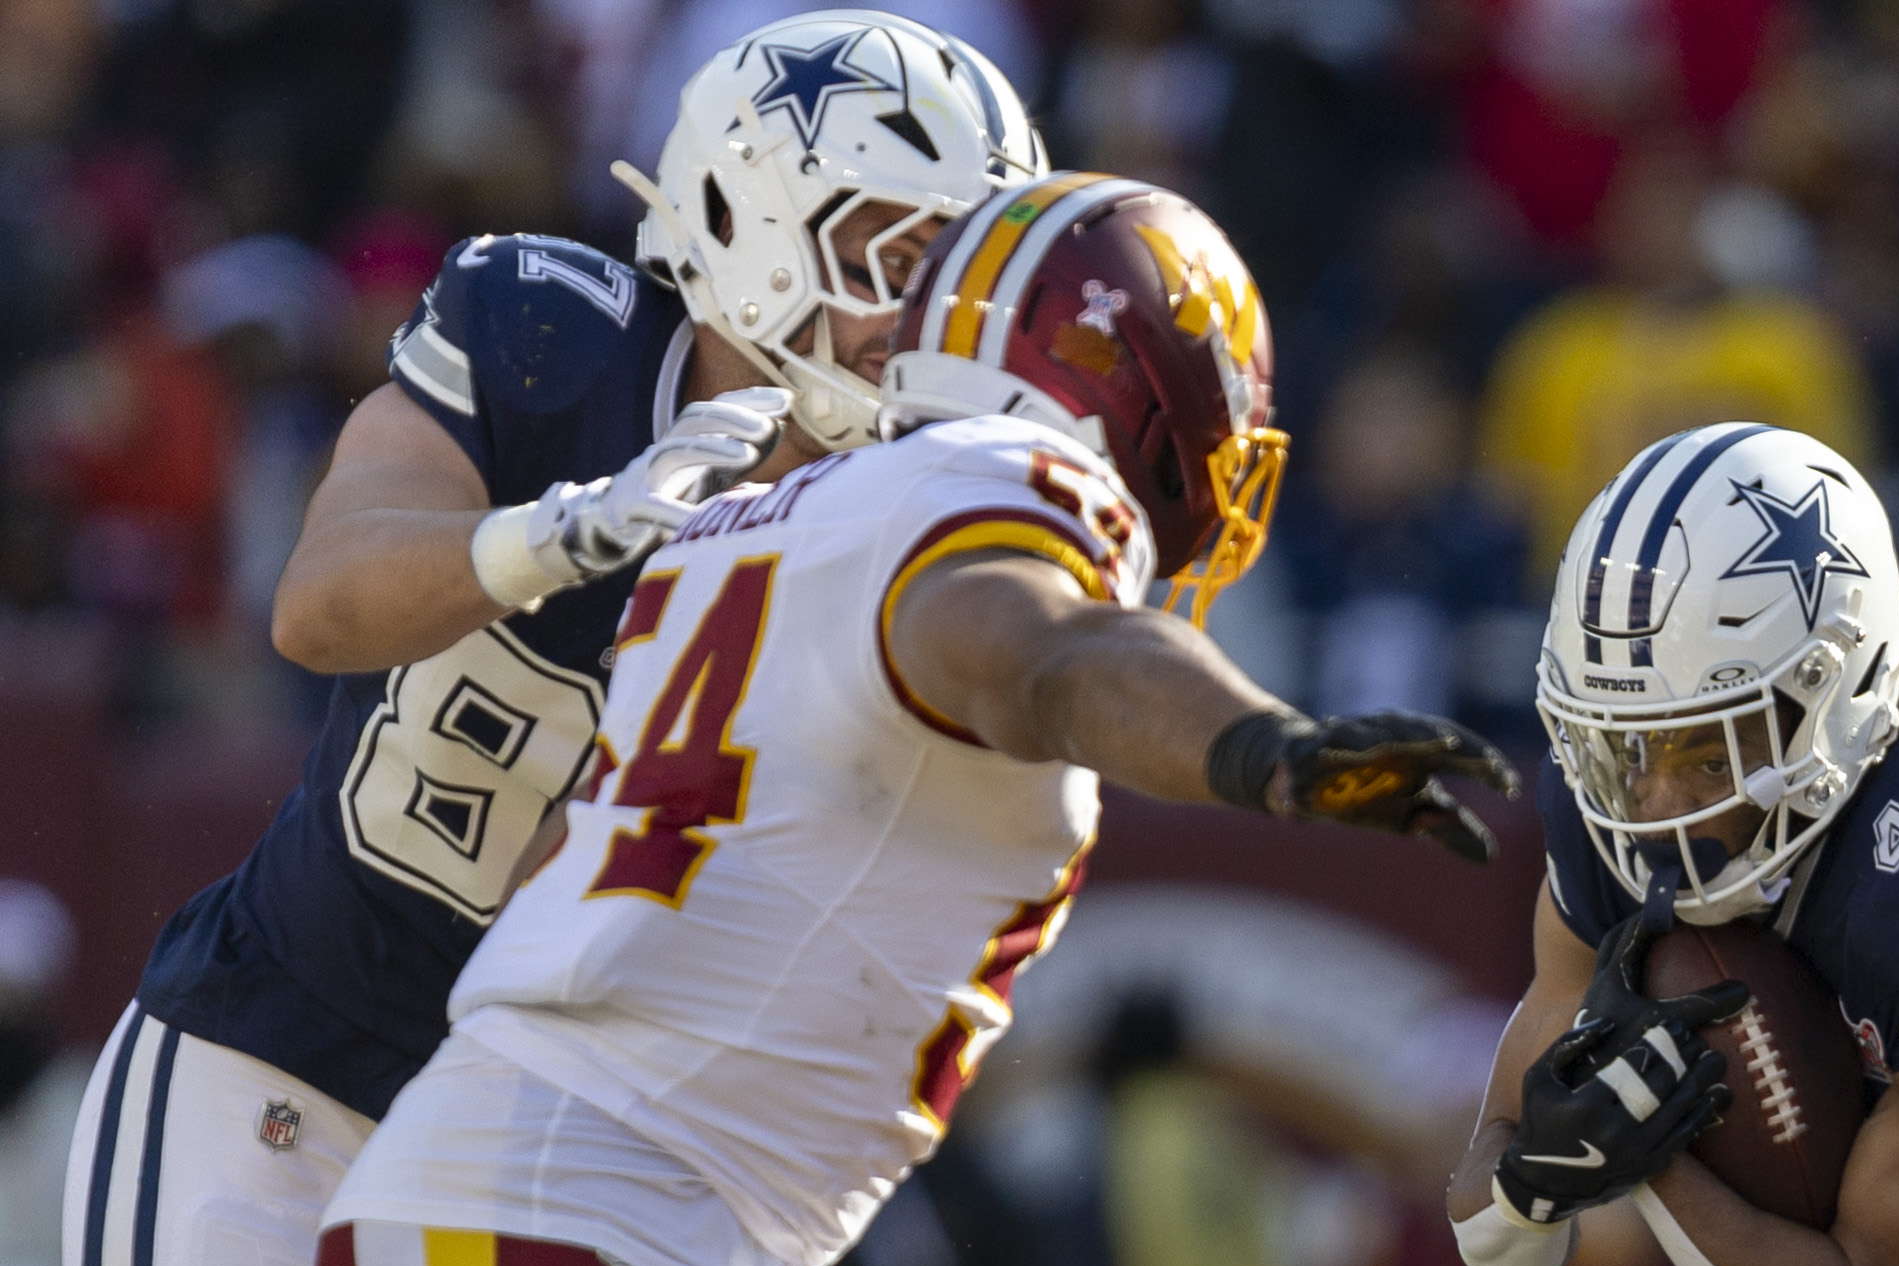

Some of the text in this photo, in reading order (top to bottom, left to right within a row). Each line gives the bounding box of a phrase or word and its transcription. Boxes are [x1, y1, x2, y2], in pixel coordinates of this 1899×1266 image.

[513, 233, 637, 331] 7
[1584, 674, 1646, 692] COWBOYS
[1702, 677, 1755, 692] OAKLEY
[264, 1119, 291, 1142] NFL
